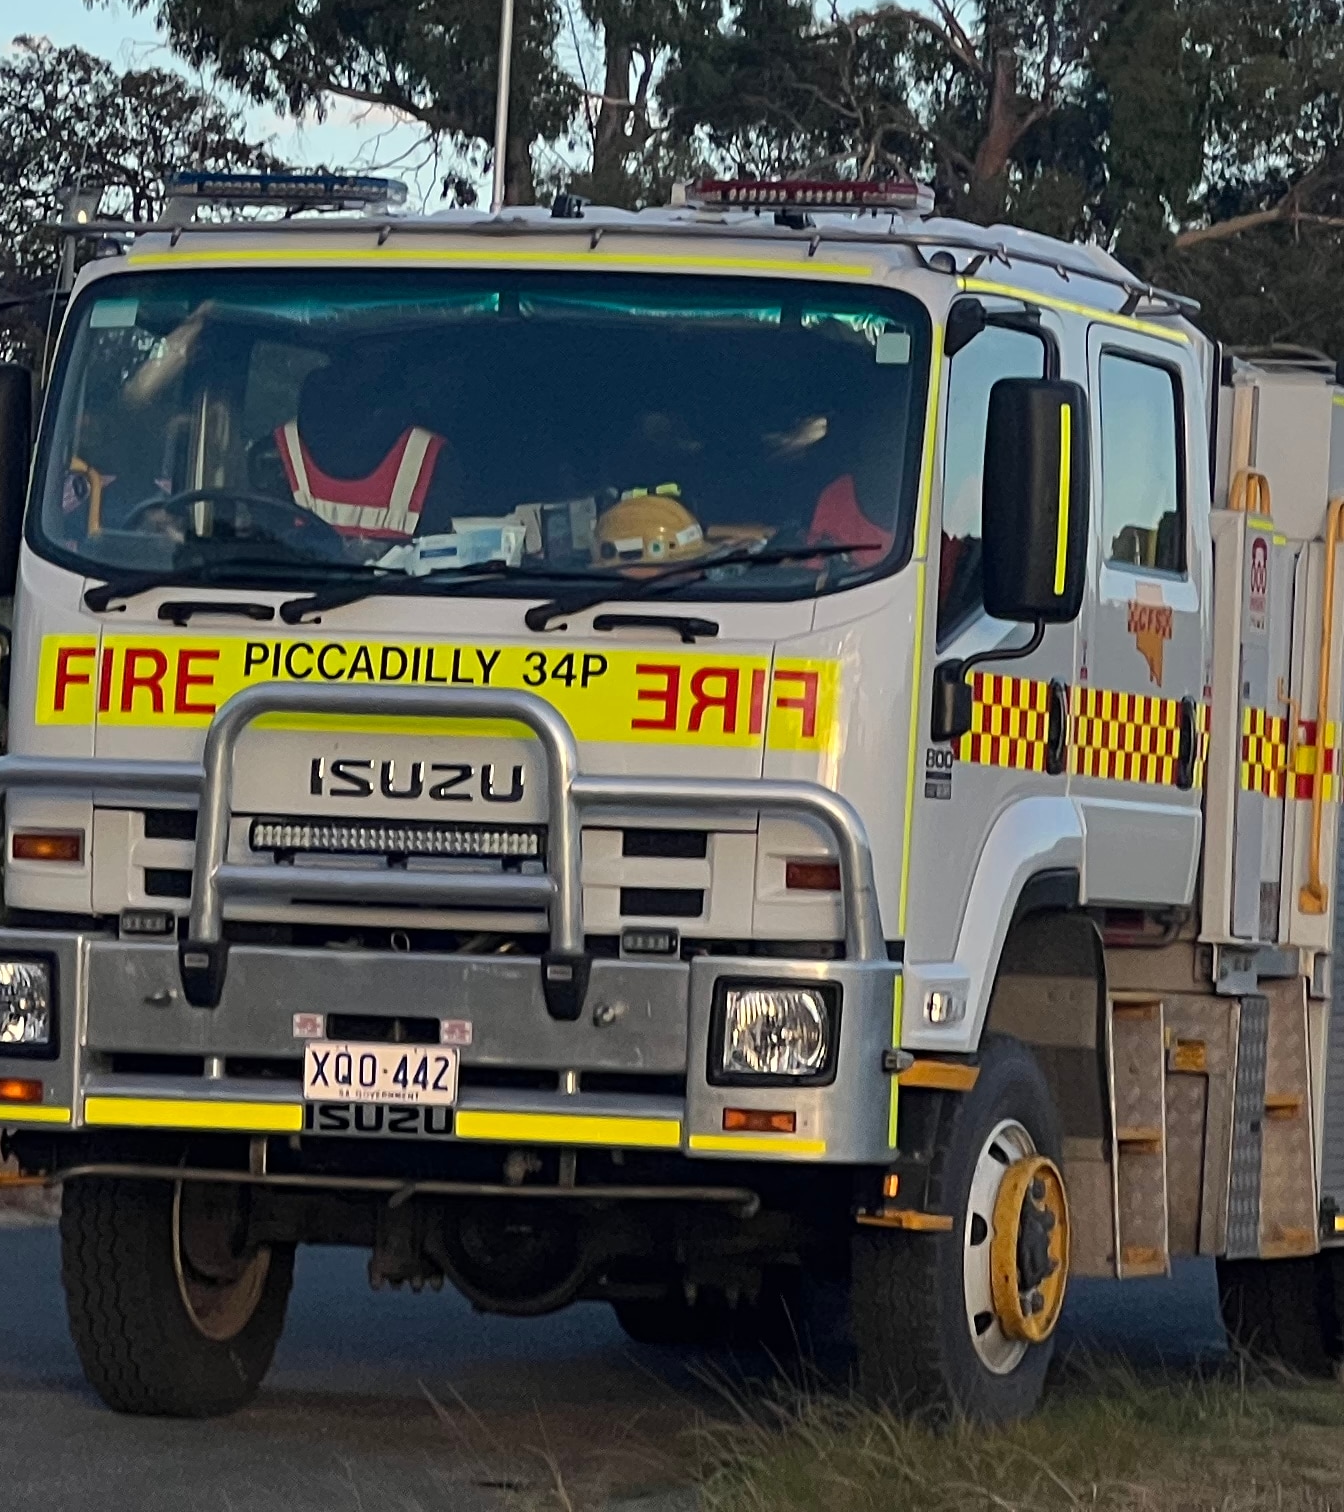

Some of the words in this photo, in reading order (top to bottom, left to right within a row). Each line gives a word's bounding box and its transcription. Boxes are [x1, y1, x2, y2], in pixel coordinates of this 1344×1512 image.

[53, 645, 222, 715] FIRE
[242, 641, 502, 687] PICCADILLY
[522, 650, 608, 689] 34P
[926, 748, 953, 768] 800
[309, 755, 526, 803] ISUZU
[306, 1103, 454, 1135] ISUZU
